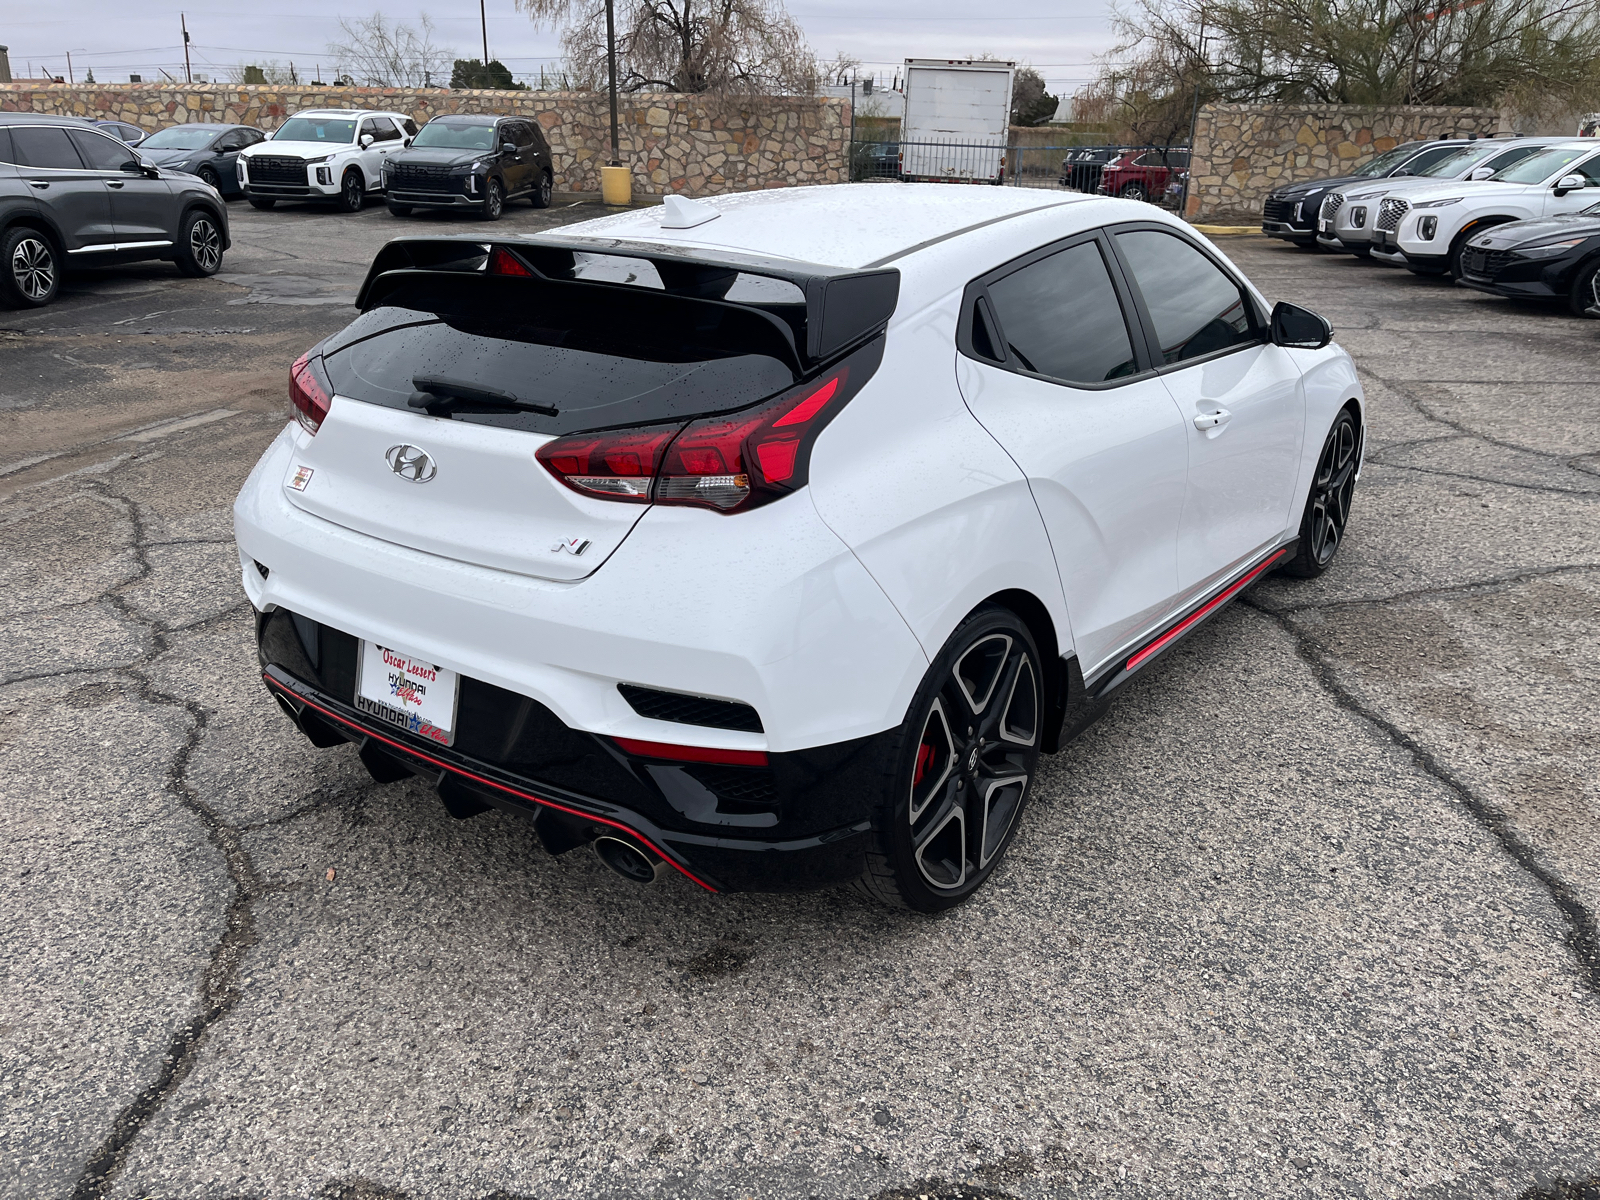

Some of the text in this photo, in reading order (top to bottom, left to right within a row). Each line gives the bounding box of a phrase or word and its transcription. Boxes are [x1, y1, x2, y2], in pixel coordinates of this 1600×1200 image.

[383, 649, 436, 682] Oscar Leeser's
[388, 672, 426, 696] HYUNDAI
[358, 696, 449, 745] HYUNDAI El Paso
